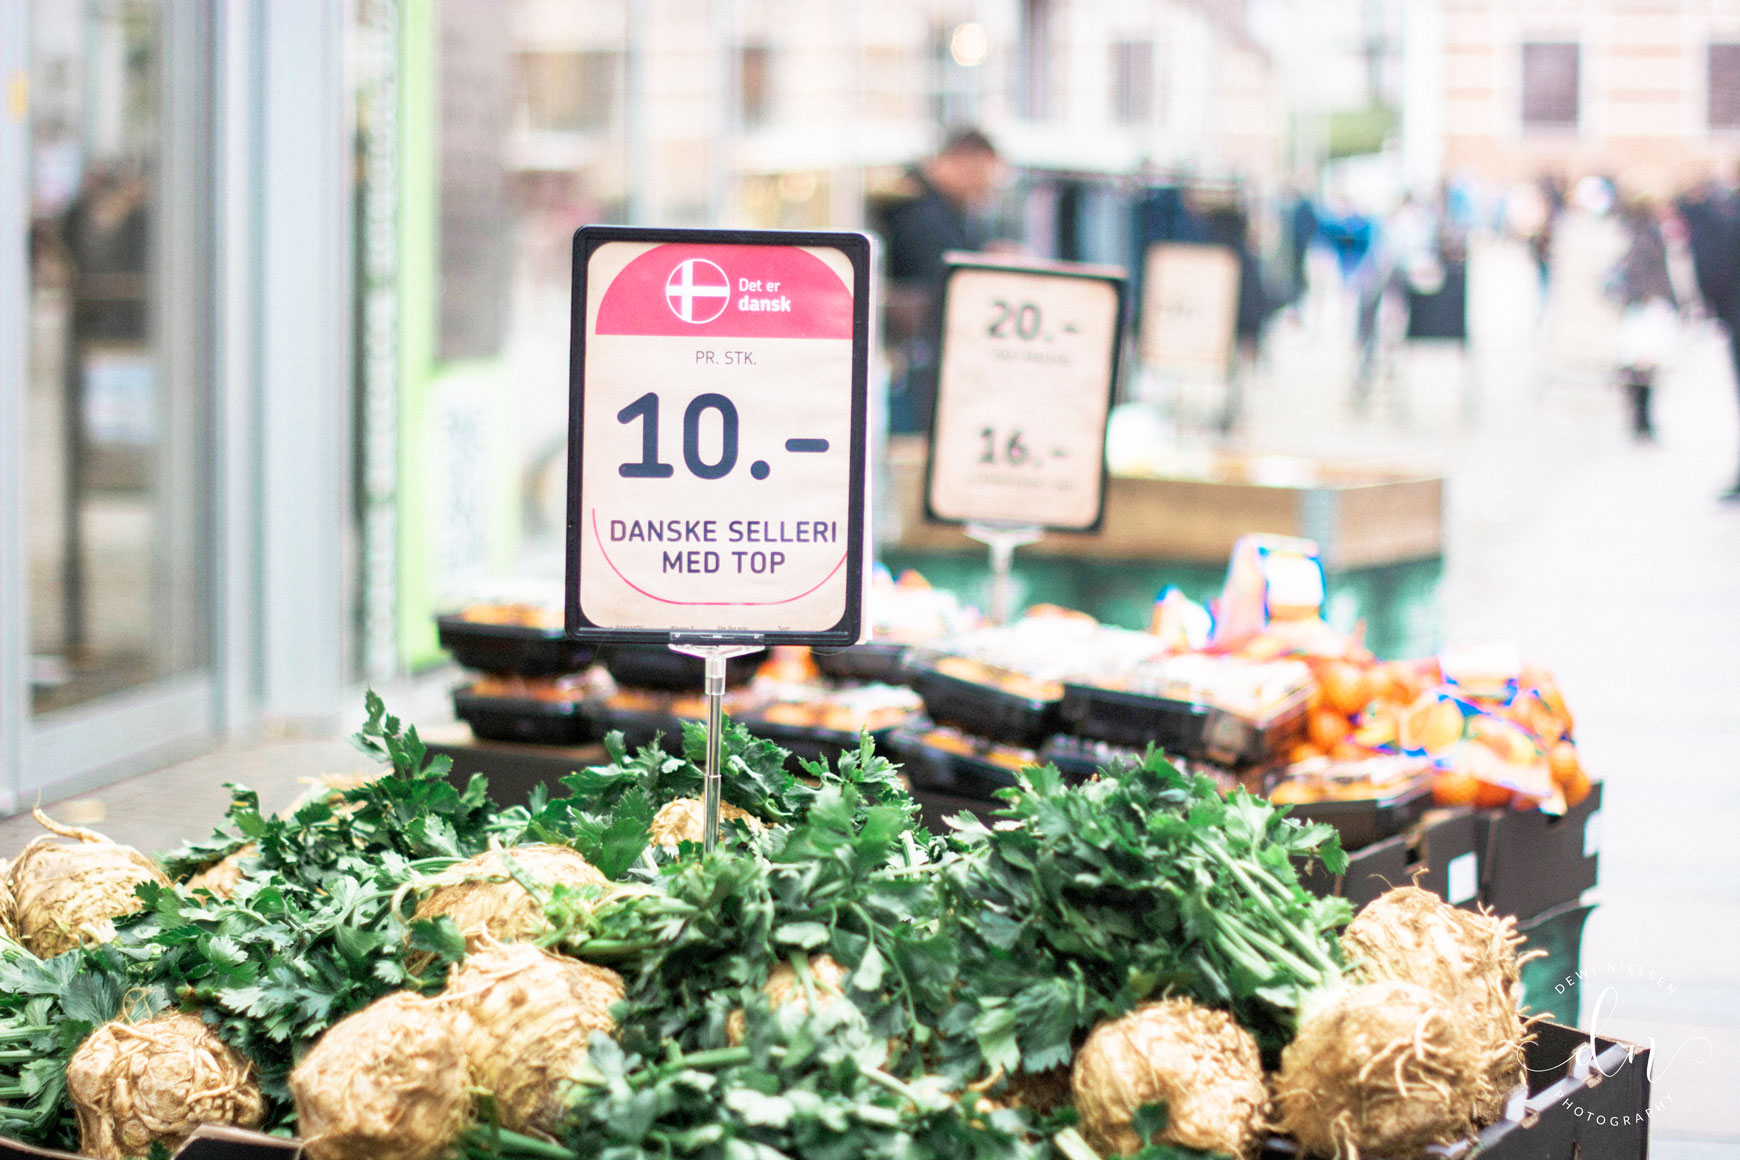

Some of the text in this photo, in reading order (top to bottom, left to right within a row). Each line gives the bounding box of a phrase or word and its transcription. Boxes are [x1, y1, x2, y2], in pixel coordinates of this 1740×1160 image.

[738, 278, 781, 292] Det er
[738, 295, 791, 312] dansk
[695, 350, 757, 366] PR. STK.
[616, 391, 830, 480] 10.-
[610, 520, 837, 543] DANSKE SELLERI
[662, 551, 786, 574] MED TOP
